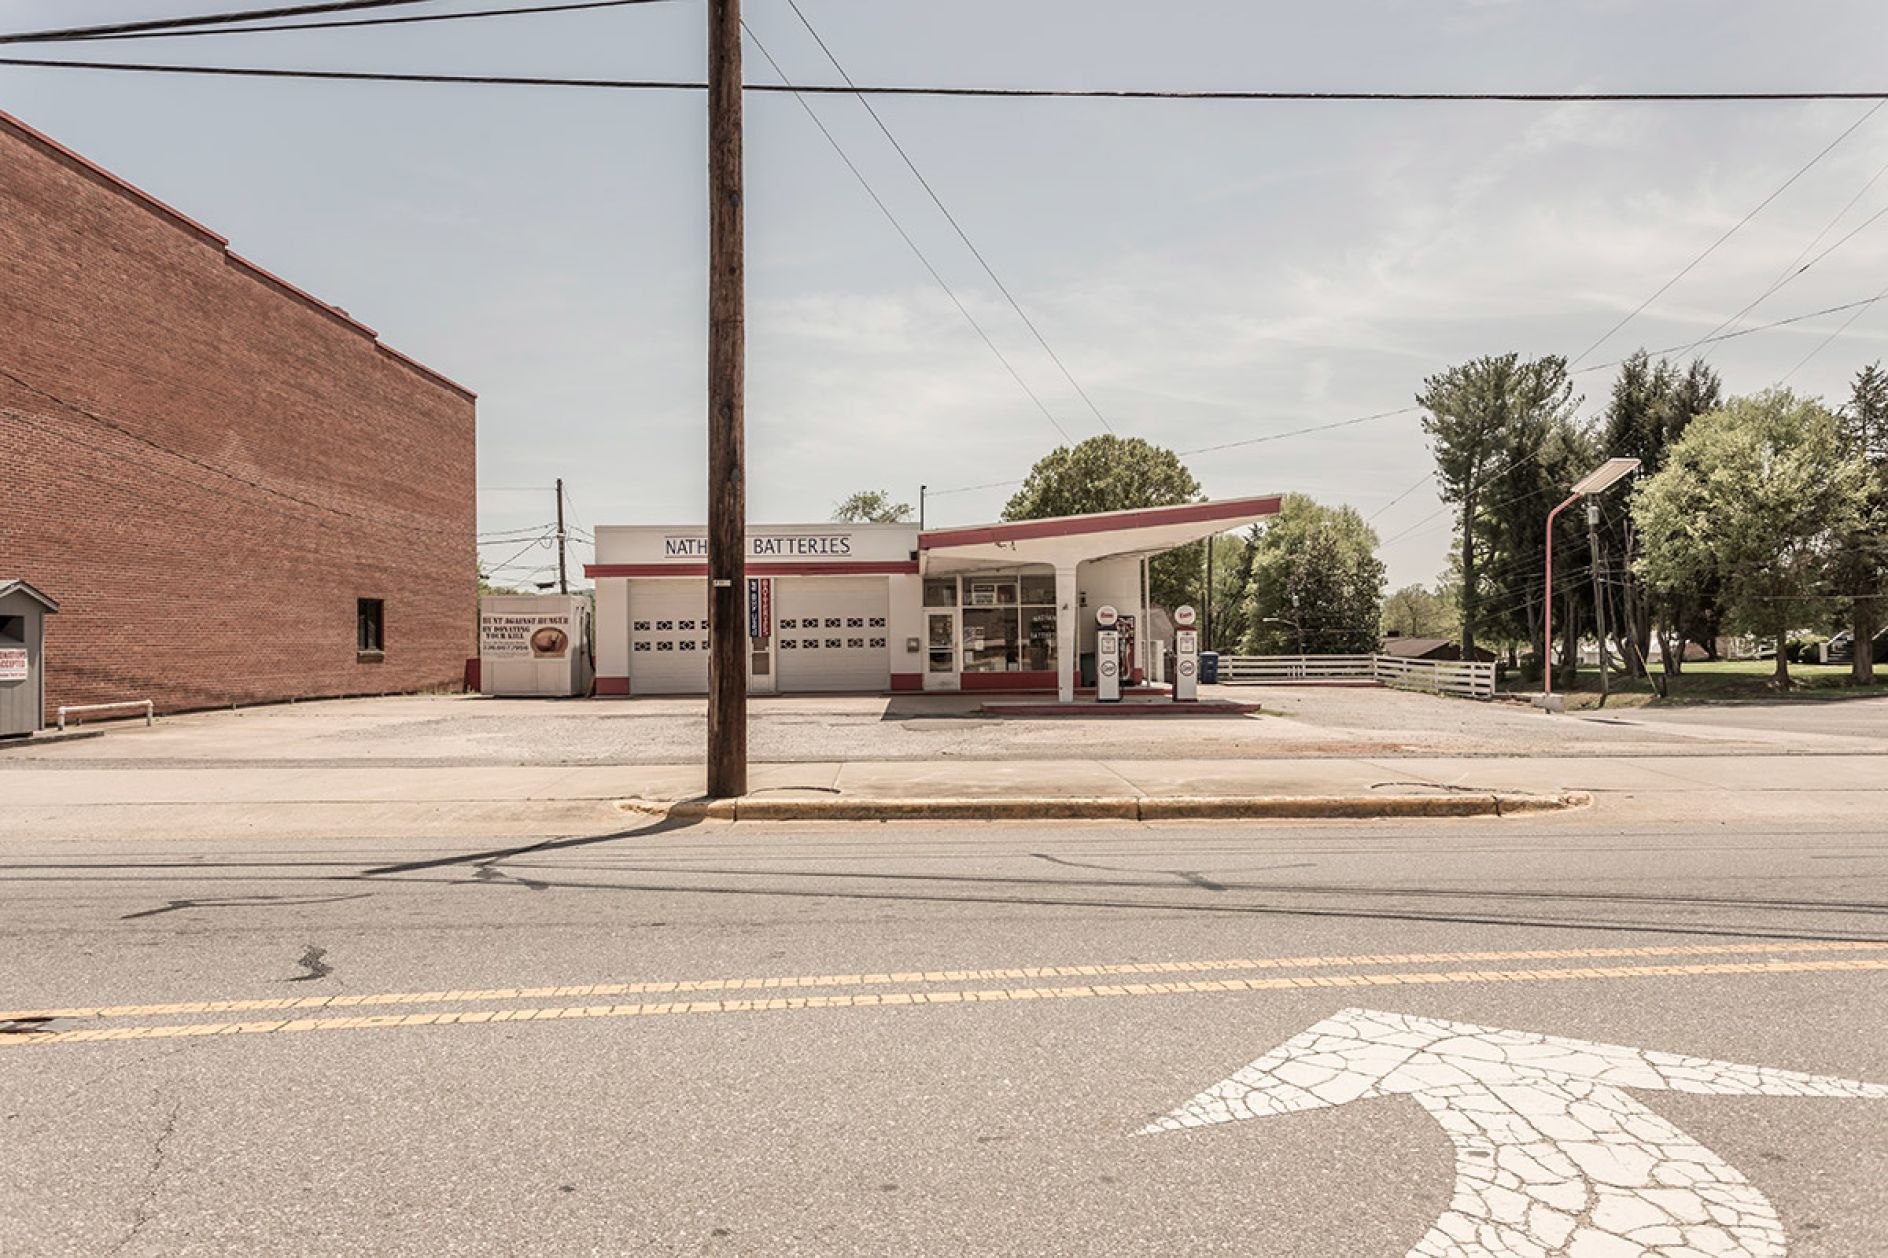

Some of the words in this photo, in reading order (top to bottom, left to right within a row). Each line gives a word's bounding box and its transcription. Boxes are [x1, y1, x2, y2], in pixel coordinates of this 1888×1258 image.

[666, 538, 708, 555] NATH
[753, 537, 851, 554] BATTERIES
[482, 617, 503, 625] HUNT
[505, 617, 536, 625] AGAINST
[537, 617, 569, 625] HUNGER
